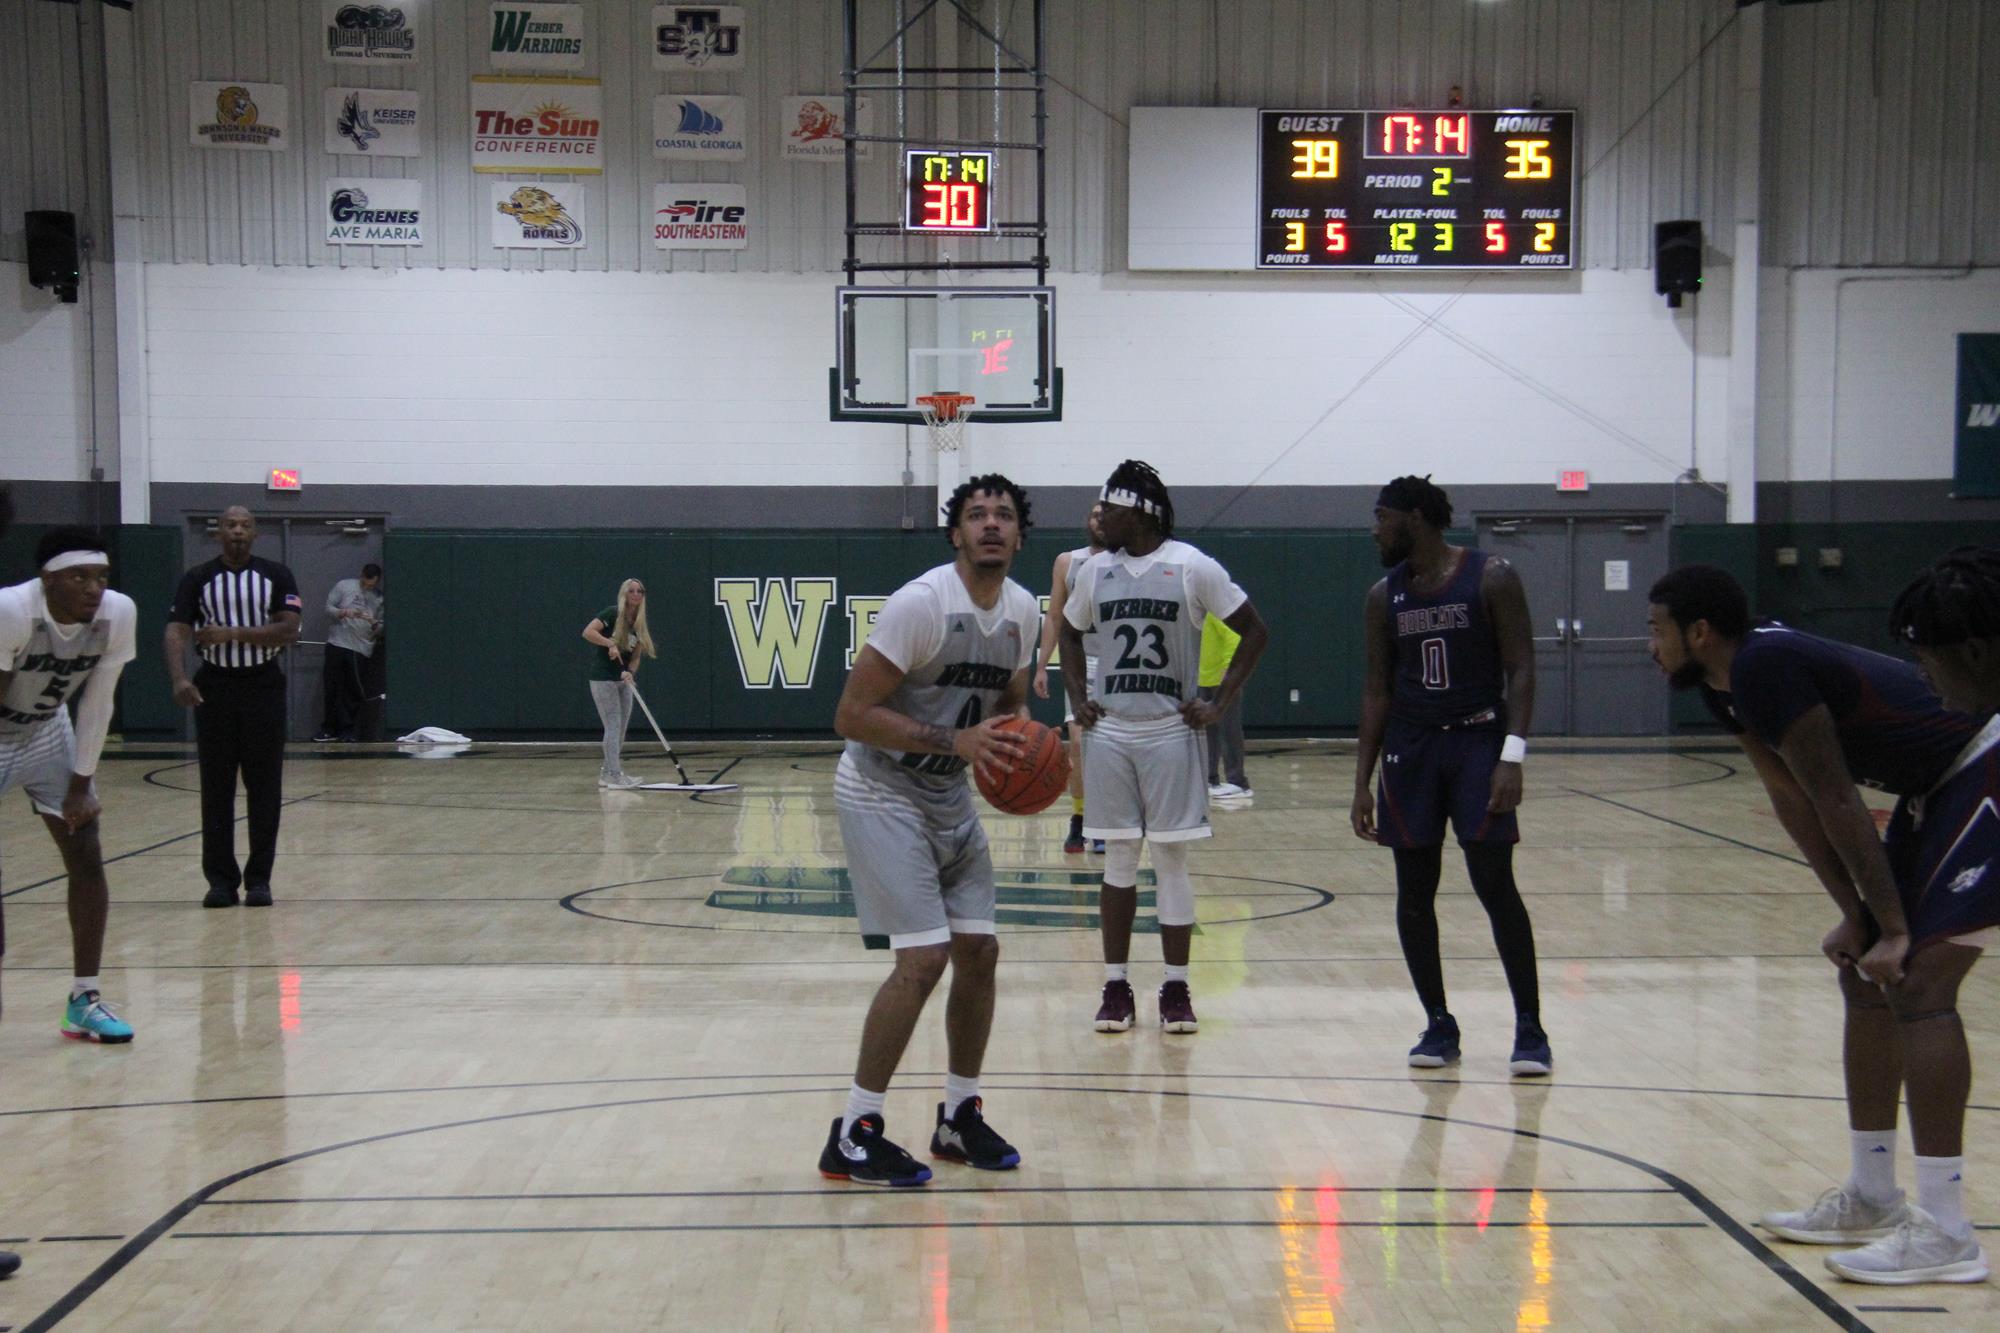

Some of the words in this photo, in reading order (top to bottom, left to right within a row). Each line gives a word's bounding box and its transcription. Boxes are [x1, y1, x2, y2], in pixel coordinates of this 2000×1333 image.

[373, 109, 416, 119] KEISER
[475, 110, 533, 135] The
[537, 110, 599, 137] Sun
[1278, 116, 1343, 132] GUEST
[1494, 116, 1553, 132] HOME
[1383, 115, 1468, 154] 17:14
[474, 140, 597, 154] CONFERENCE
[655, 139, 697, 149] COASTAL
[701, 140, 743, 150] GEORGIA
[1291, 140, 1339, 178] 39
[1503, 140, 1552, 179] 35
[1364, 175, 1423, 188] PERIOD
[1431, 167, 1452, 196] 2
[922, 184, 976, 226] 30
[1271, 208, 1310, 219] FOULS
[1324, 208, 1347, 219] TOL
[1373, 208, 1458, 219] PLAYER-FOUL
[1483, 208, 1507, 219] TOL
[1521, 208, 1562, 219] FOULS
[329, 226, 360, 239] AVE
[365, 226, 420, 240] MARIA
[523, 228, 569, 239] ROYALS
[655, 224, 746, 240] SOUTHEASTERN
[1284, 222, 1305, 251] 3
[1326, 222, 1347, 252] 5
[1389, 222, 1417, 251] 12
[1433, 222, 1453, 251] 3
[1485, 222, 1508, 252] 5
[1534, 222, 1556, 252] 2
[1265, 254, 1310, 264] POINTS
[1374, 254, 1419, 264] MATCH
[1520, 254, 1565, 264] POINTS
[1396, 603, 1470, 636] BOBCATS
[1113, 624, 1169, 669] 23
[1421, 637, 1450, 690] 0
[34, 675, 70, 711] 5
